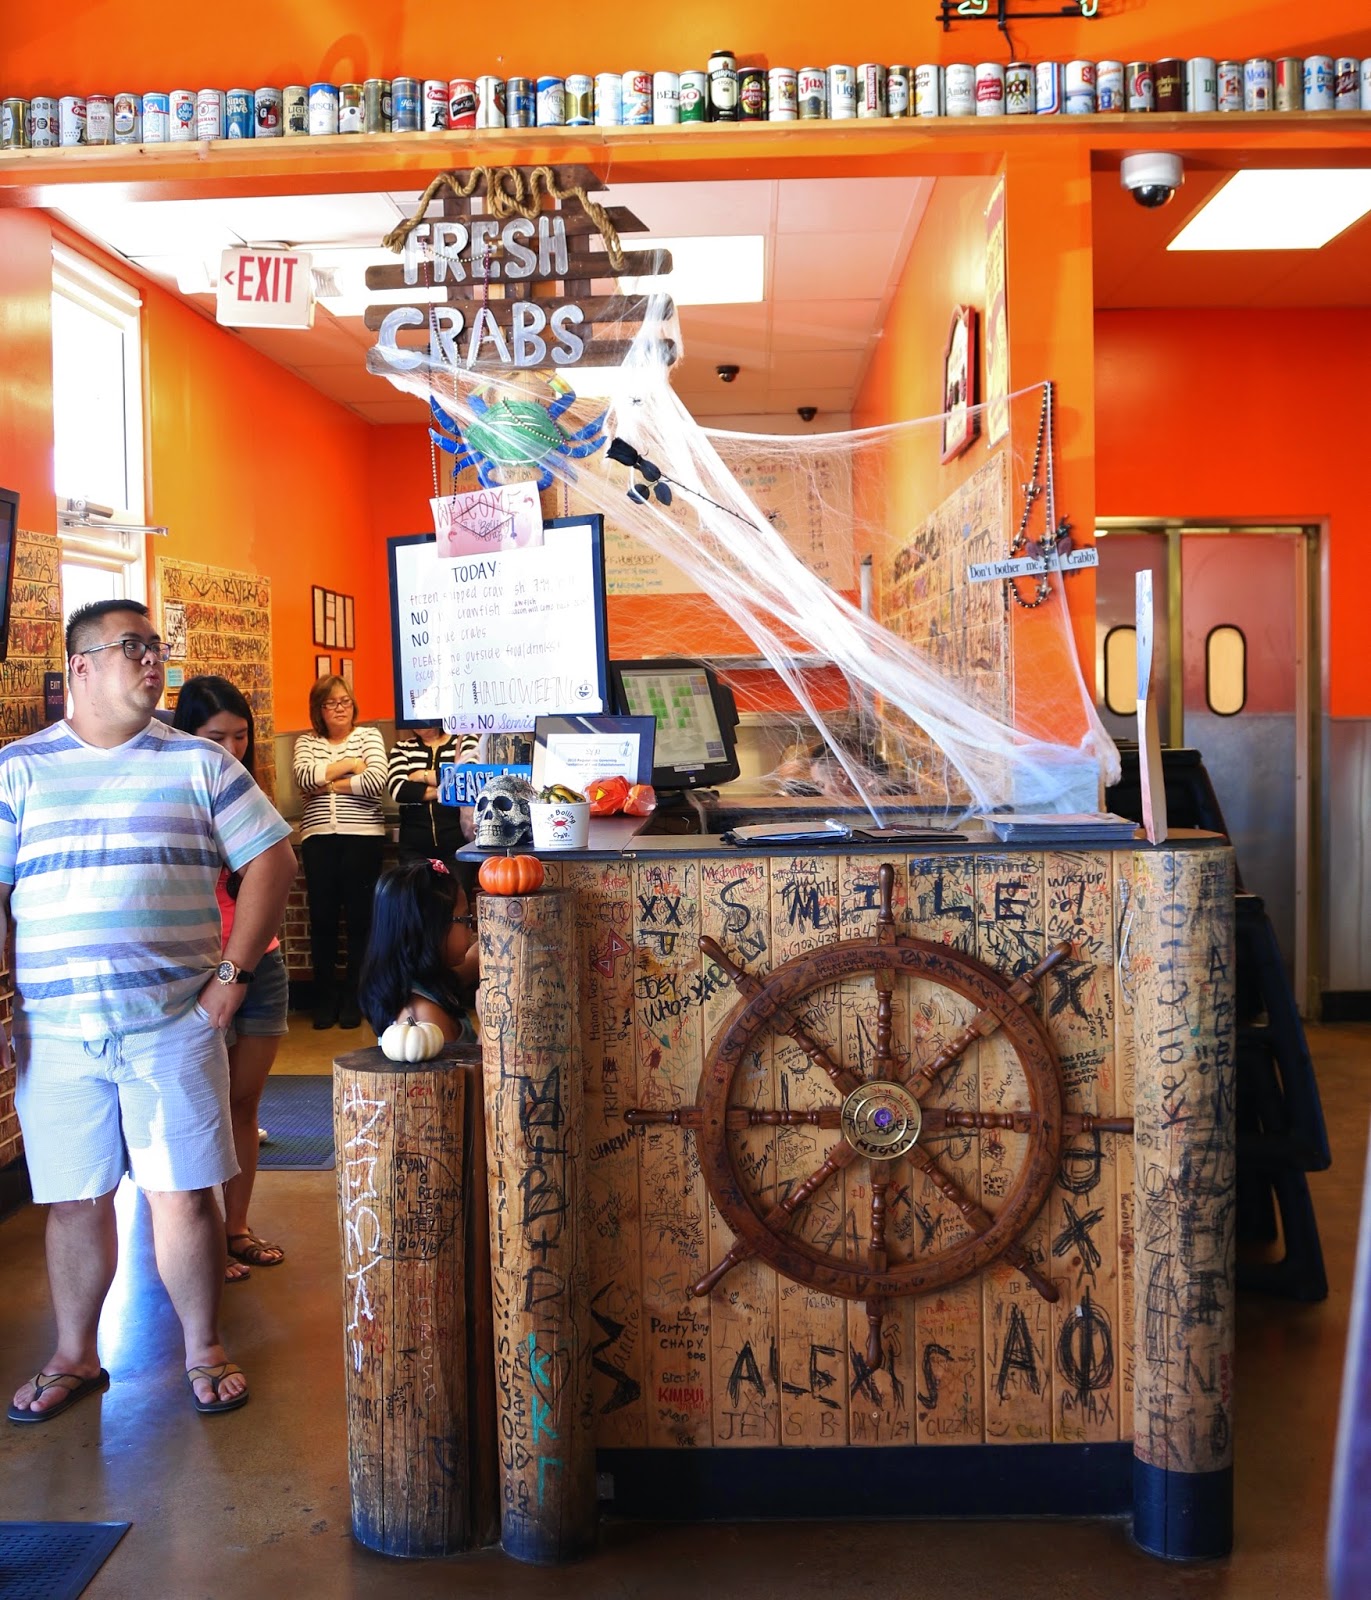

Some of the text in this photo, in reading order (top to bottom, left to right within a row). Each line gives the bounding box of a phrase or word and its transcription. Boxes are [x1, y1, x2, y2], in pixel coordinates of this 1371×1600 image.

[800, 77, 823, 94] Jax
[310, 103, 334, 111] BUSCH
[404, 215, 569, 285] FRESH
[237, 256, 298, 303] EXIT
[375, 302, 585, 370] CRABS
[438, 489, 521, 529] WELCOME
[451, 560, 502, 583] TODAY:
[969, 565, 992, 579] Don't
[994, 562, 1020, 575] bother
[1067, 552, 1097, 565] Crabby
[410, 609, 429, 626] NO
[411, 631, 429, 648] NO
[50, 680, 61, 690] EXIT
[443, 714, 536, 730] NO NO Servic
[644, 996, 691, 1027] WHO?
[650, 1317, 688, 1337] Party
